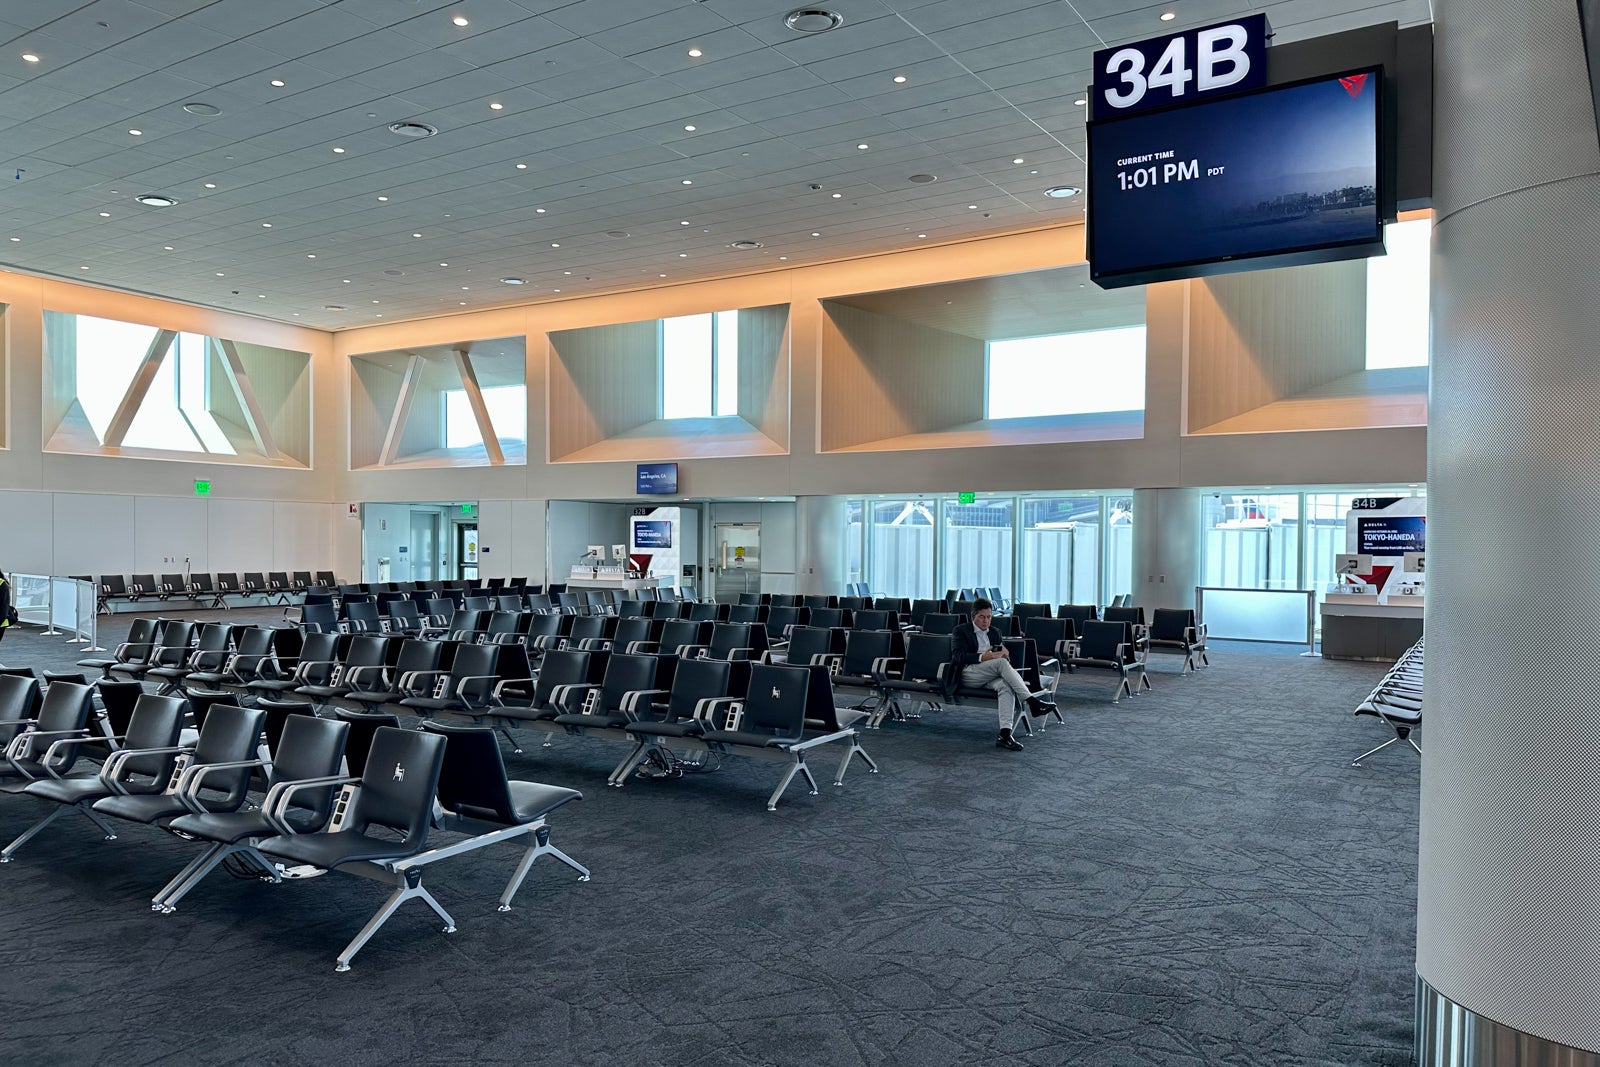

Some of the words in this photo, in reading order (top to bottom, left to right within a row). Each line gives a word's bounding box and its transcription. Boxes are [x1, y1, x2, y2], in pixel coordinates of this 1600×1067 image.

[1104, 24, 1250, 109] 34B
[1117, 154, 1153, 167] CURRENT
[1154, 150, 1175, 160] TIME
[1117, 166, 1157, 190] 1:01
[1163, 159, 1199, 184] PM
[1207, 166, 1225, 177] PDT
[1352, 498, 1377, 509] 34B
[1363, 533, 1415, 541] TOKYO-HANEDA
